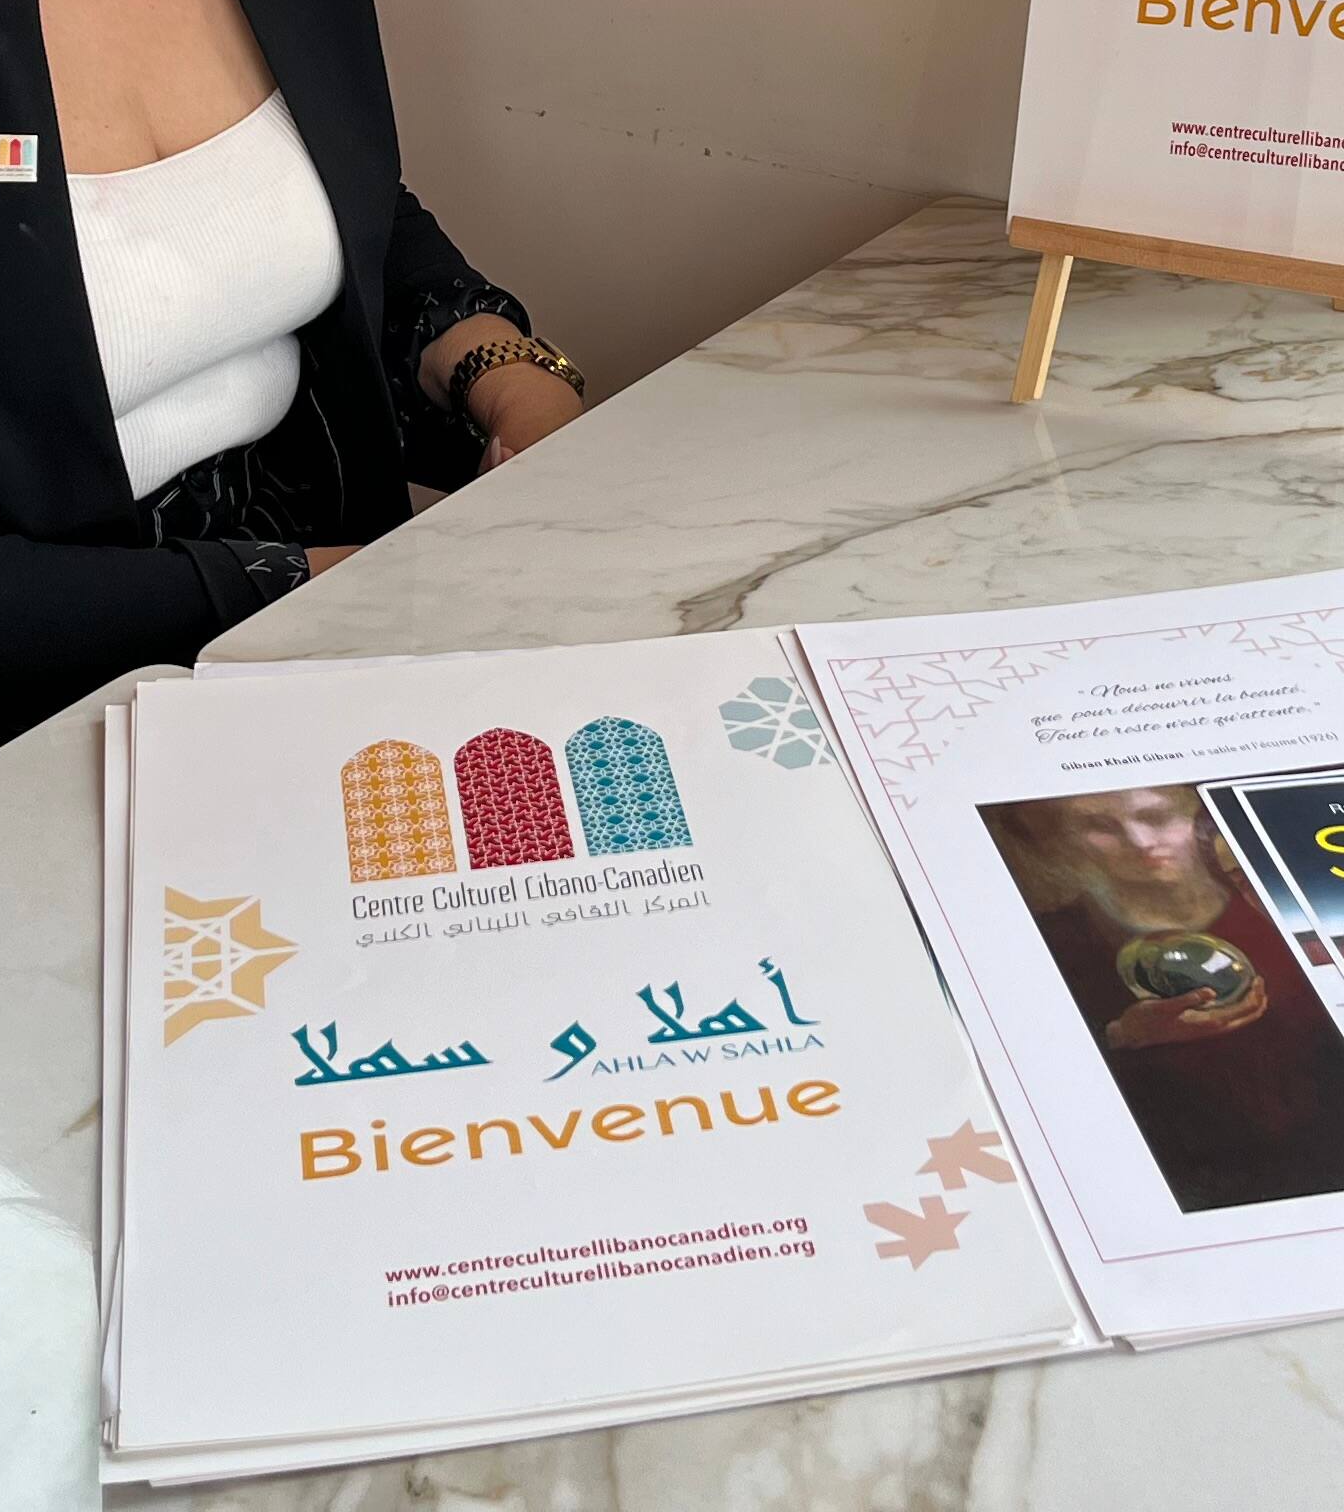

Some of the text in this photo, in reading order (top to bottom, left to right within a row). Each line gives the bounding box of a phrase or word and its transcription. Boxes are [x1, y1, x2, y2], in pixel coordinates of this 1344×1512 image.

[1031, 714, 1062, 727] que
[1071, 707, 1117, 722] pour
[1035, 728, 1088, 744] Tout
[1060, 760, 1103, 772] Gibran
[1105, 754, 1141, 767] Khalil
[1143, 750, 1184, 763] Gibran
[1297, 731, 1339, 746] (1926)
[352, 859, 704, 920] Centre Culturel Libano-Canadien
[643, 890, 712, 916] المركز
[541, 899, 632, 927] الثقافي
[291, 956, 822, 1087] أهلا و سهلا
[591, 1034, 825, 1077] AHLA W SAHLA
[298, 1078, 843, 1181] Bienvenue
[384, 1216, 808, 1283] www.centreculturellibanocanadien.org
[387, 1238, 816, 1308] info@centreculturellibanocanadien.org
